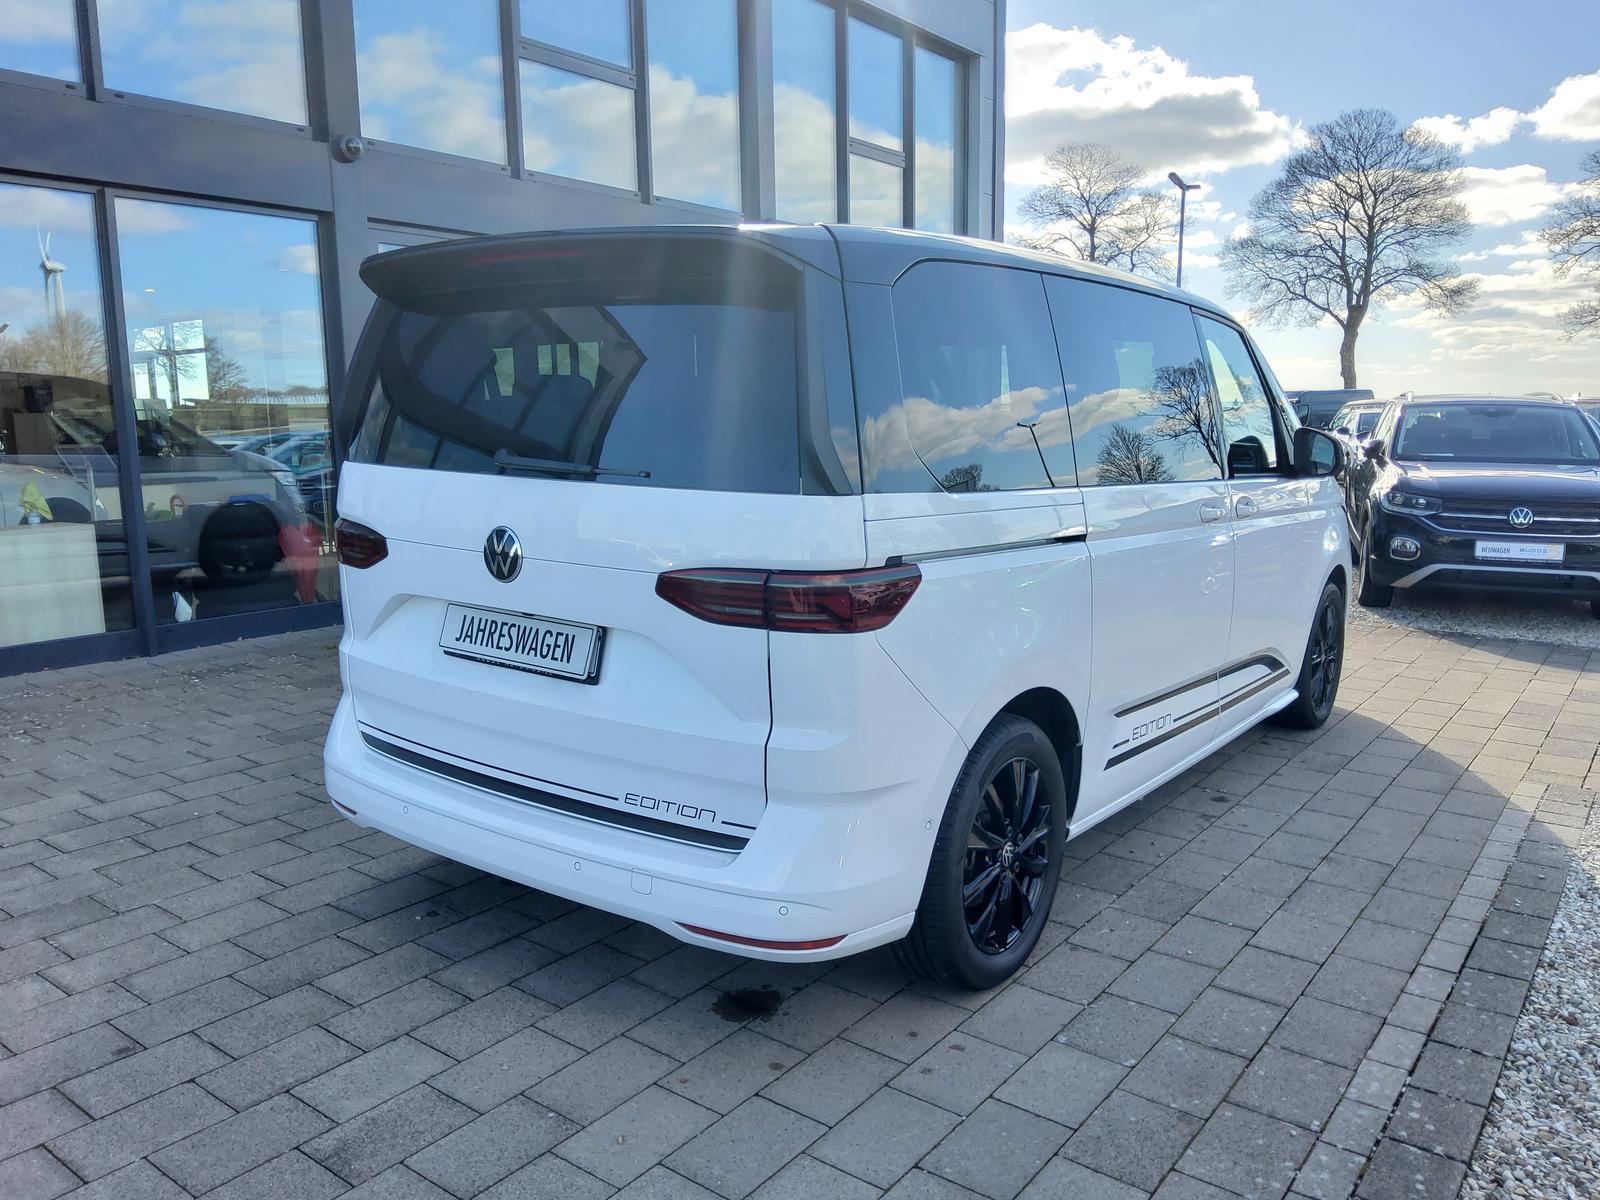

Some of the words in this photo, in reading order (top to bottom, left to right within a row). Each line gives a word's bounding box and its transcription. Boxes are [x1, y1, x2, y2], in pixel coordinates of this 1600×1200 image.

[1509, 507, 1533, 528] VW
[483, 525, 523, 583] VW
[1481, 546, 1511, 555] NEUWAGEN
[455, 614, 576, 664] JAHRESWAGEN
[1132, 713, 1172, 741] EDITION
[624, 792, 717, 823] EDITION
